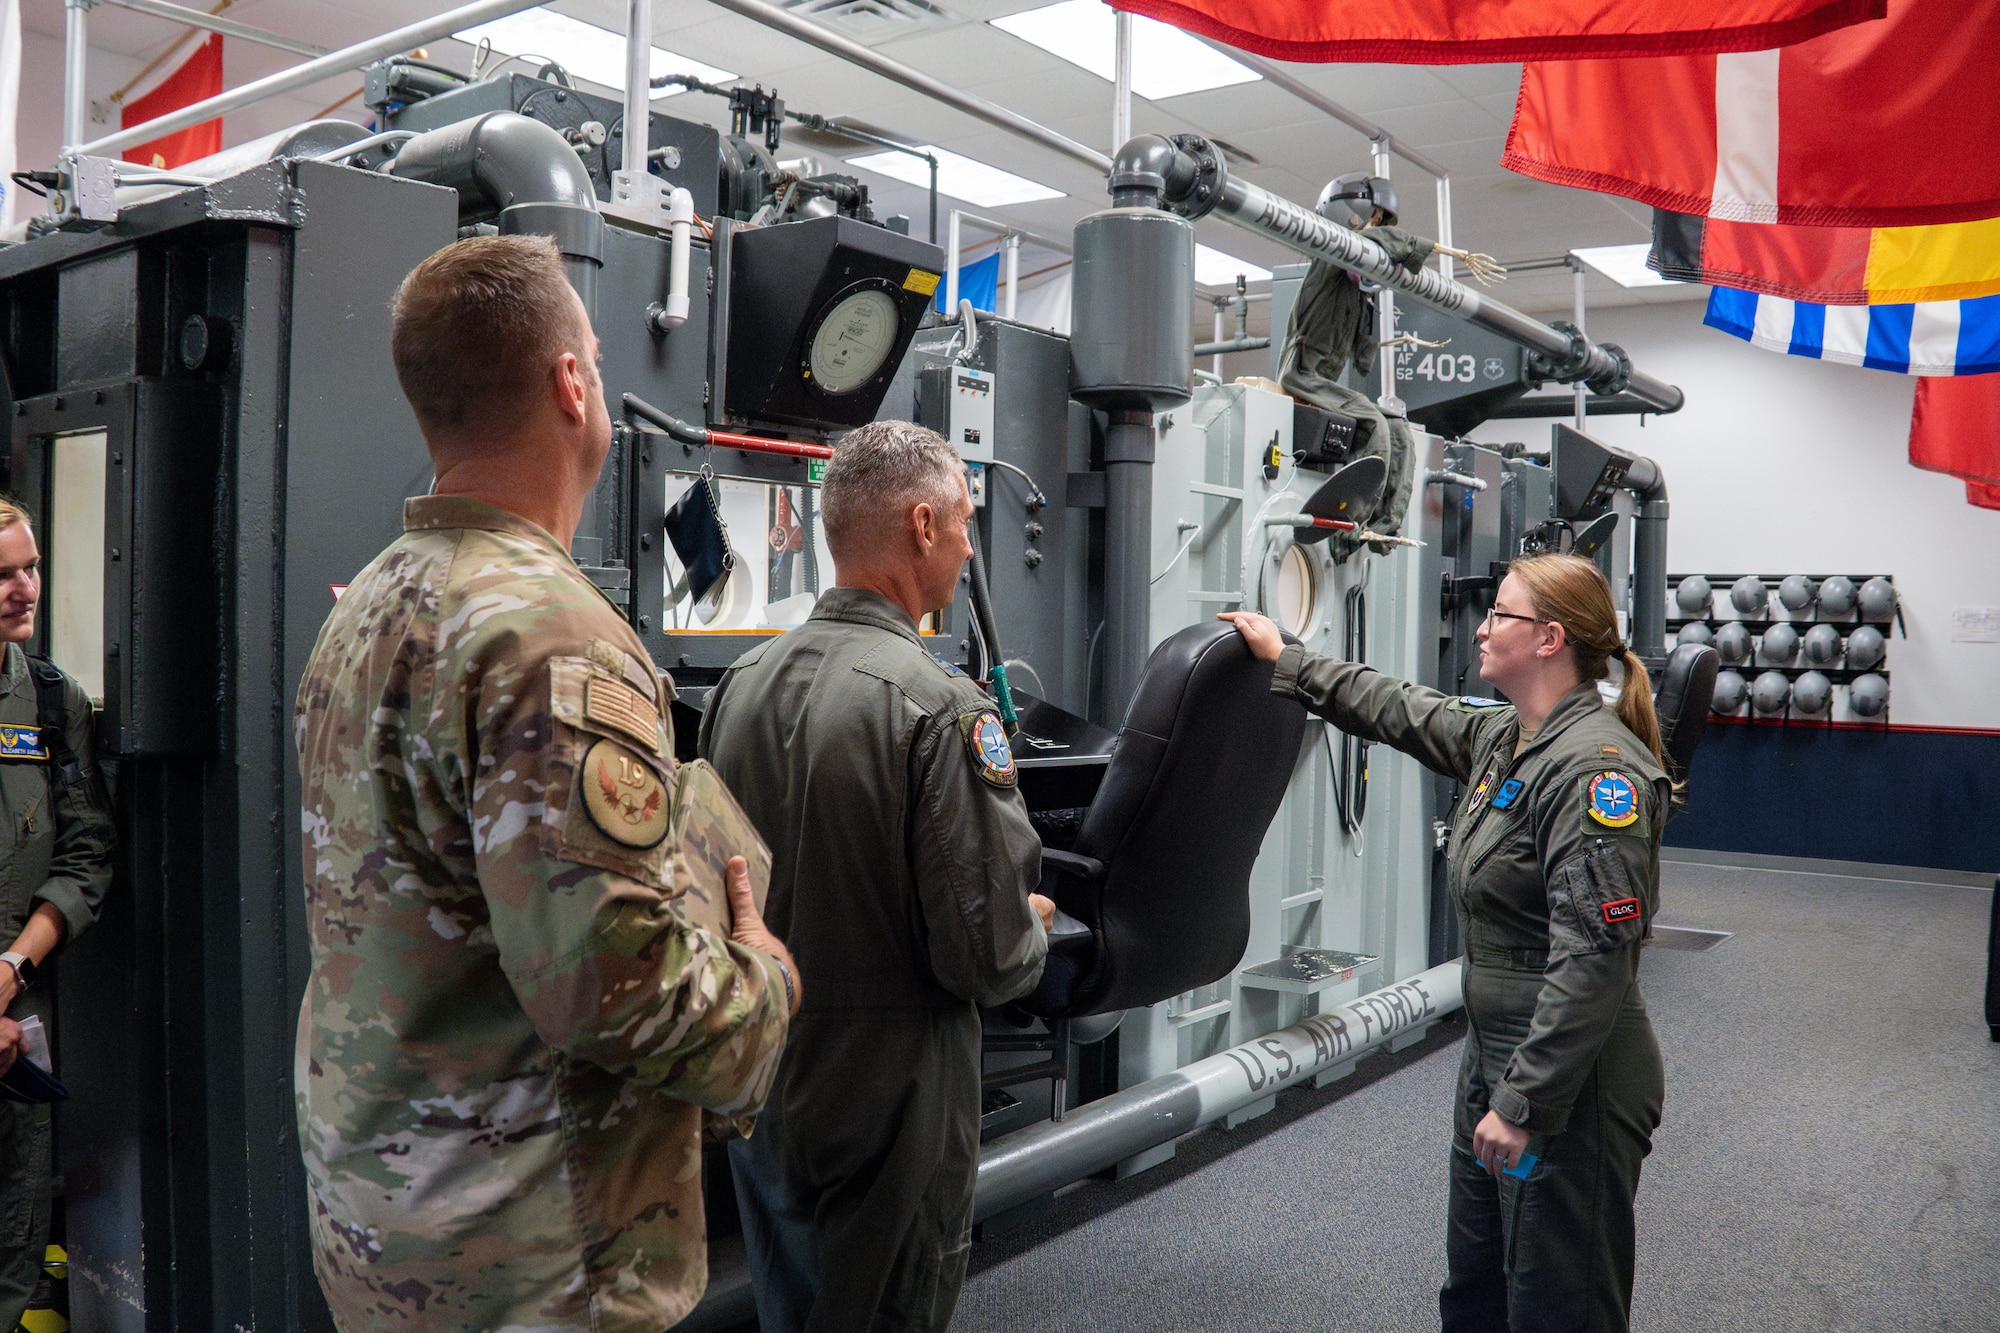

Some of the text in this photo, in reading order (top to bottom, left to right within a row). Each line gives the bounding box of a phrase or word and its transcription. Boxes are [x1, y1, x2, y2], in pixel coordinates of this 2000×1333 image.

[1255, 191, 1370, 269] AEROSPACE
[1396, 367, 1414, 380] 52
[1397, 353, 1414, 365] AF
[1416, 353, 1476, 382] 403
[619, 756, 646, 789] 19
[1610, 904, 1634, 916] GLOC
[1225, 979, 1436, 1092] U.S. AIR FORCE
